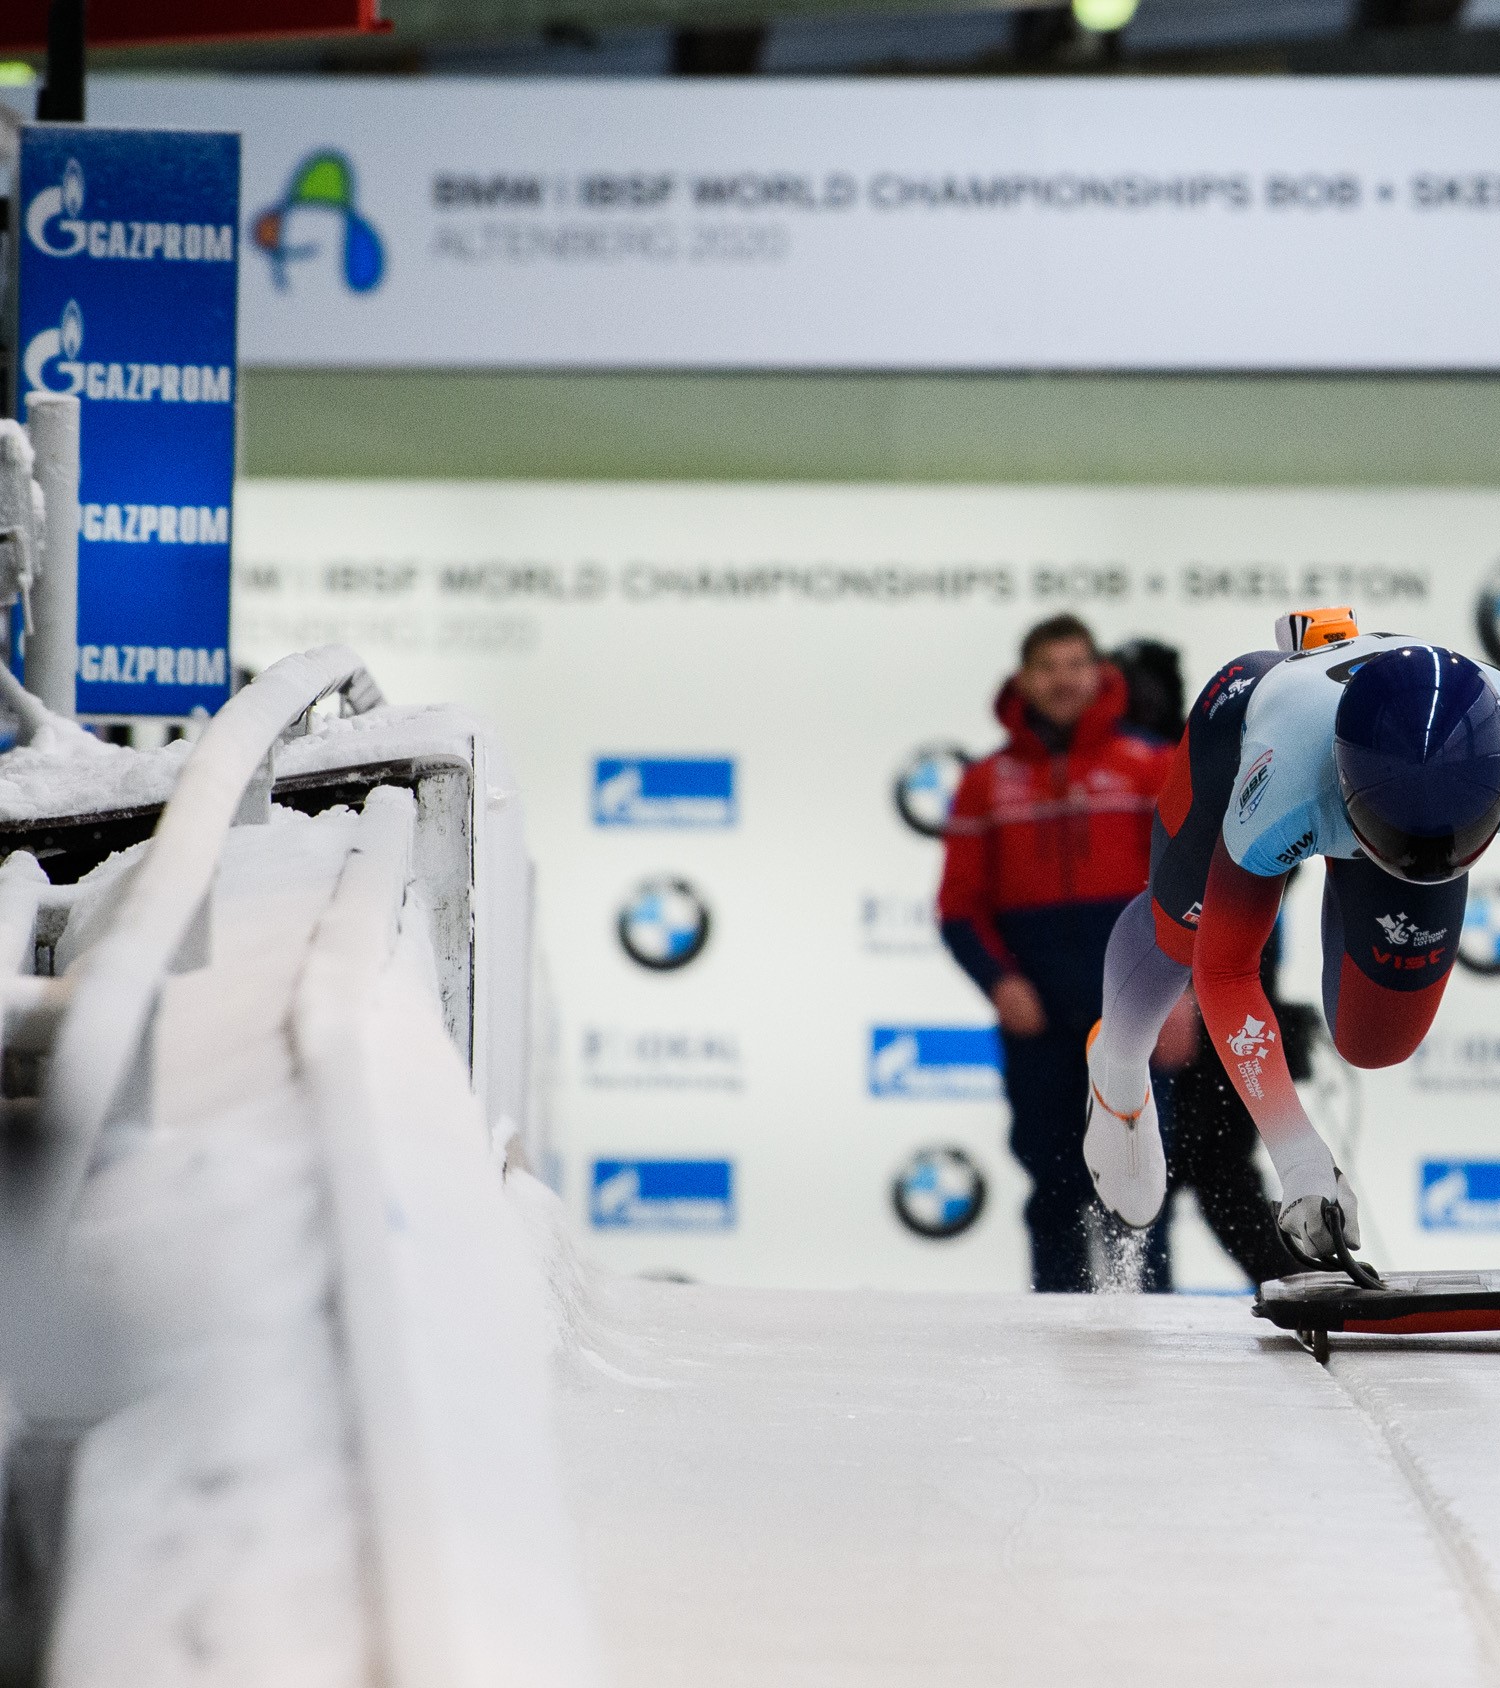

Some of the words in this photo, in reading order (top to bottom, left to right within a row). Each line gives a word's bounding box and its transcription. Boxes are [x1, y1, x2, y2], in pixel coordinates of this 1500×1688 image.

[691, 174, 857, 211] WORLD
[867, 173, 1252, 212] CHAMPIONSHIPS
[1265, 173, 1361, 212] BOB
[87, 219, 234, 262] GAZPROM
[431, 219, 678, 264] ALTENBERG
[85, 361, 231, 402] GAZPROM
[82, 503, 229, 545] GAZPROM
[438, 563, 608, 602] WORLD
[620, 563, 1017, 604] CHAMPIONSHIPS
[1030, 562, 1133, 602] BOB
[1180, 562, 1430, 603] SKELETON
[80, 644, 227, 686] GAZPROM
[1240, 764, 1269, 810] IBSF
[1275, 830, 1316, 866] BMW
[1413, 927, 1448, 942] NATIONAL
[1413, 934, 1444, 947] LOTTERY
[1415, 930, 1430, 938] THE
[1237, 1063, 1258, 1098] LOTTERY
[1244, 1060, 1265, 1100] NATIONAL
[1251, 1058, 1263, 1076] THE
